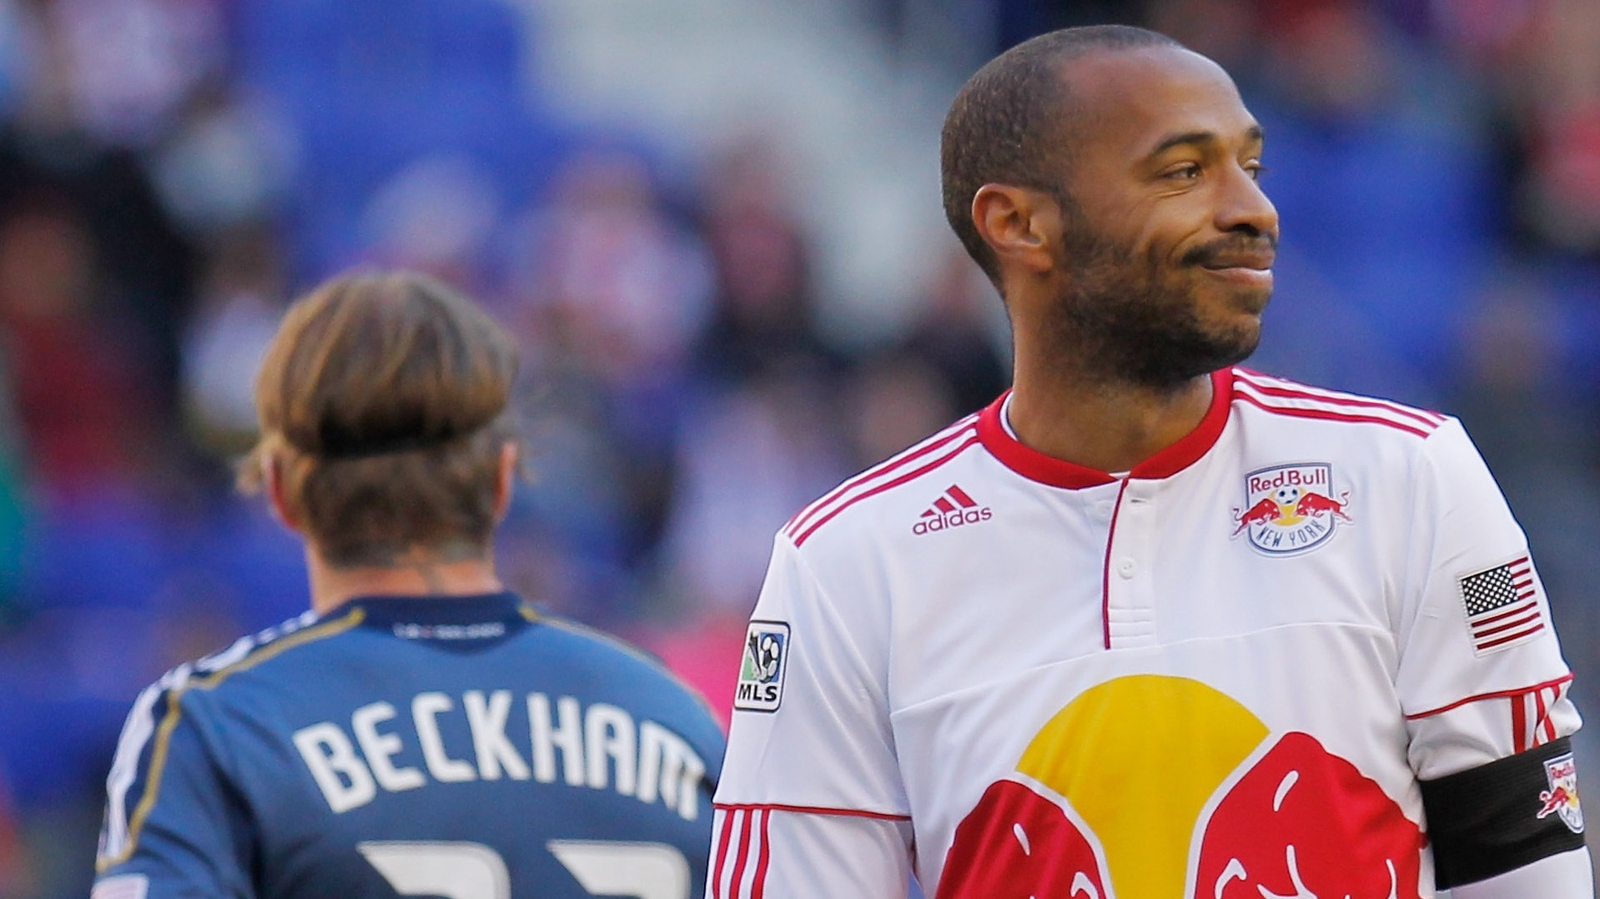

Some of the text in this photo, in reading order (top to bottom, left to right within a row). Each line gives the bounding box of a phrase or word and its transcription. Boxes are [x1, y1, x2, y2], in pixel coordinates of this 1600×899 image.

[1250, 468, 1326, 494] Red Bull
[912, 507, 992, 535] adidas
[1256, 519, 1326, 547] NEW YORK
[738, 683, 778, 702] MLS
[292, 689, 706, 821] BECKHAM
